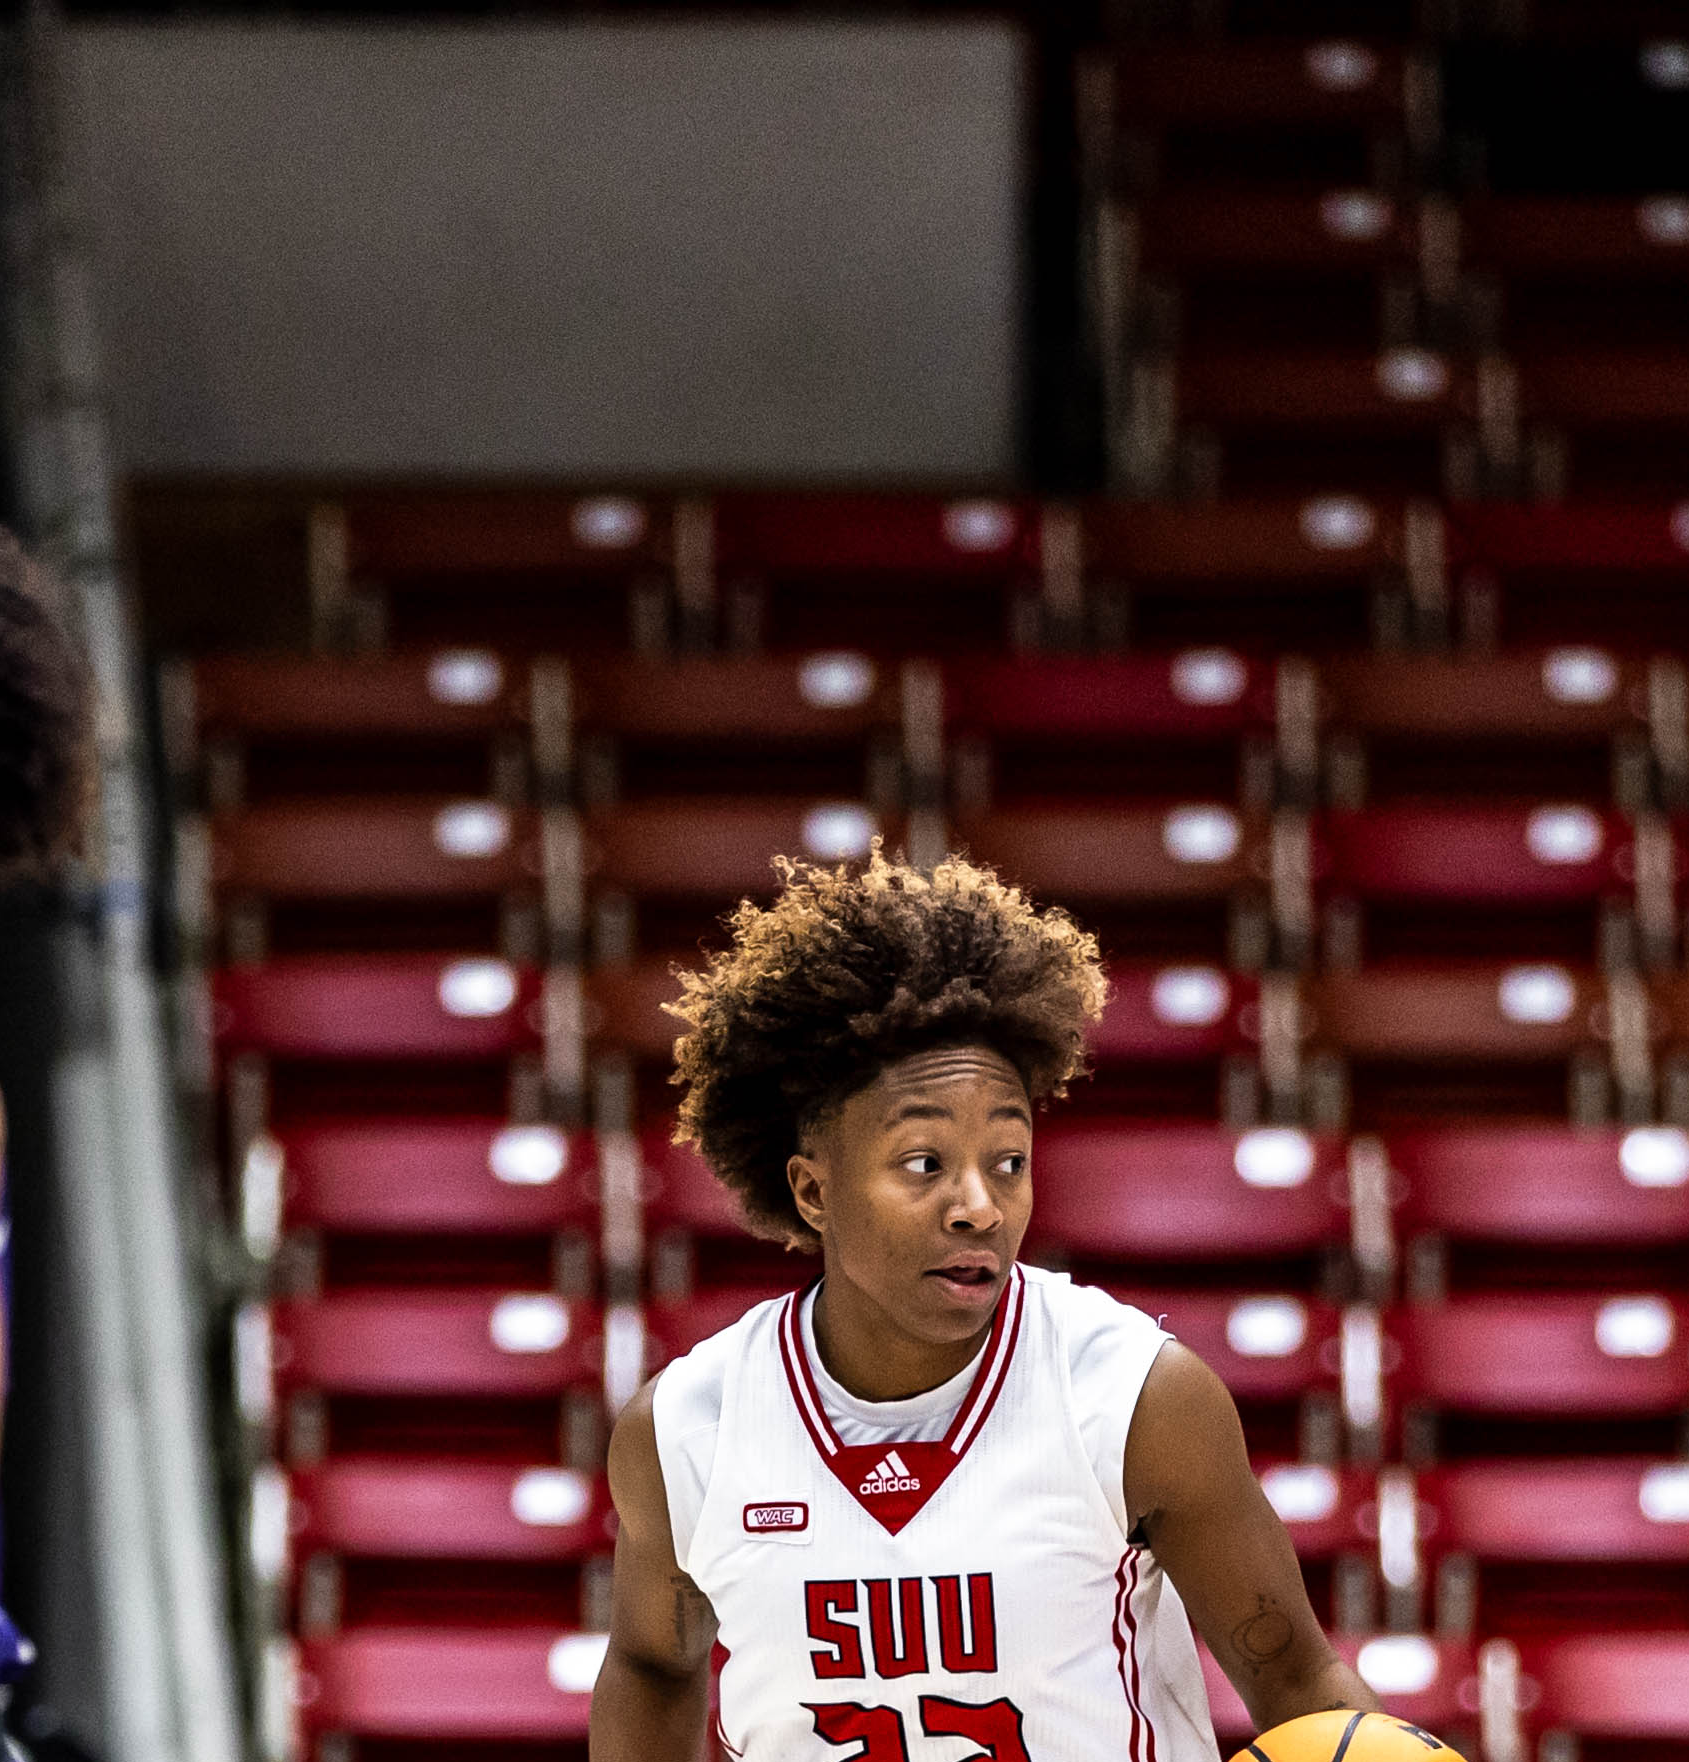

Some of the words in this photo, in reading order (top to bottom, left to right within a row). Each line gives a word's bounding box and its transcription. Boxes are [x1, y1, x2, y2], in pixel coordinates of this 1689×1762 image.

[859, 1475, 921, 1495] adidas
[754, 1508, 795, 1525] WAC
[804, 1571, 998, 1681] SUU
